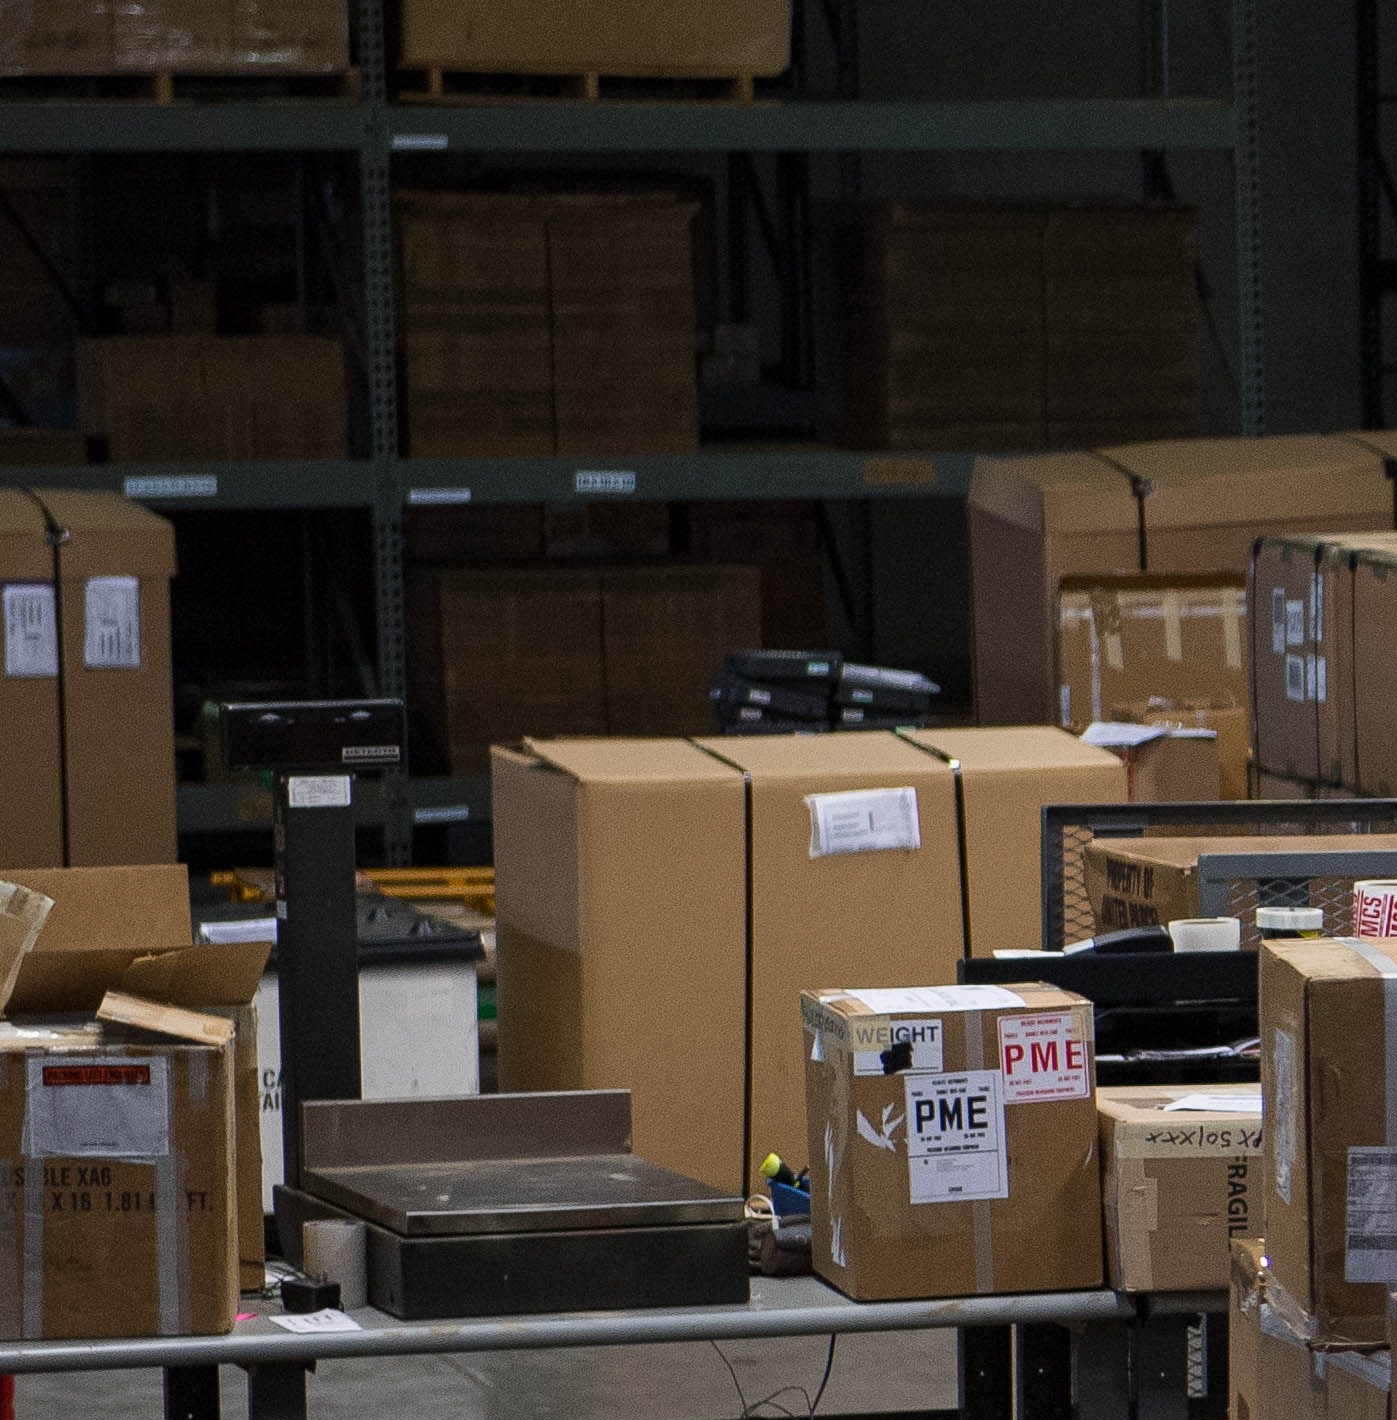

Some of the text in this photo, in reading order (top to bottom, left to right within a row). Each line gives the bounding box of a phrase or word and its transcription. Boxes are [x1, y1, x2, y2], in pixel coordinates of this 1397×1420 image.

[857, 1026, 939, 1045] WEIGHT
[1005, 1040, 1083, 1075] PME
[914, 1096, 988, 1134] PME
[1227, 1157, 1248, 1243] RAGIL
